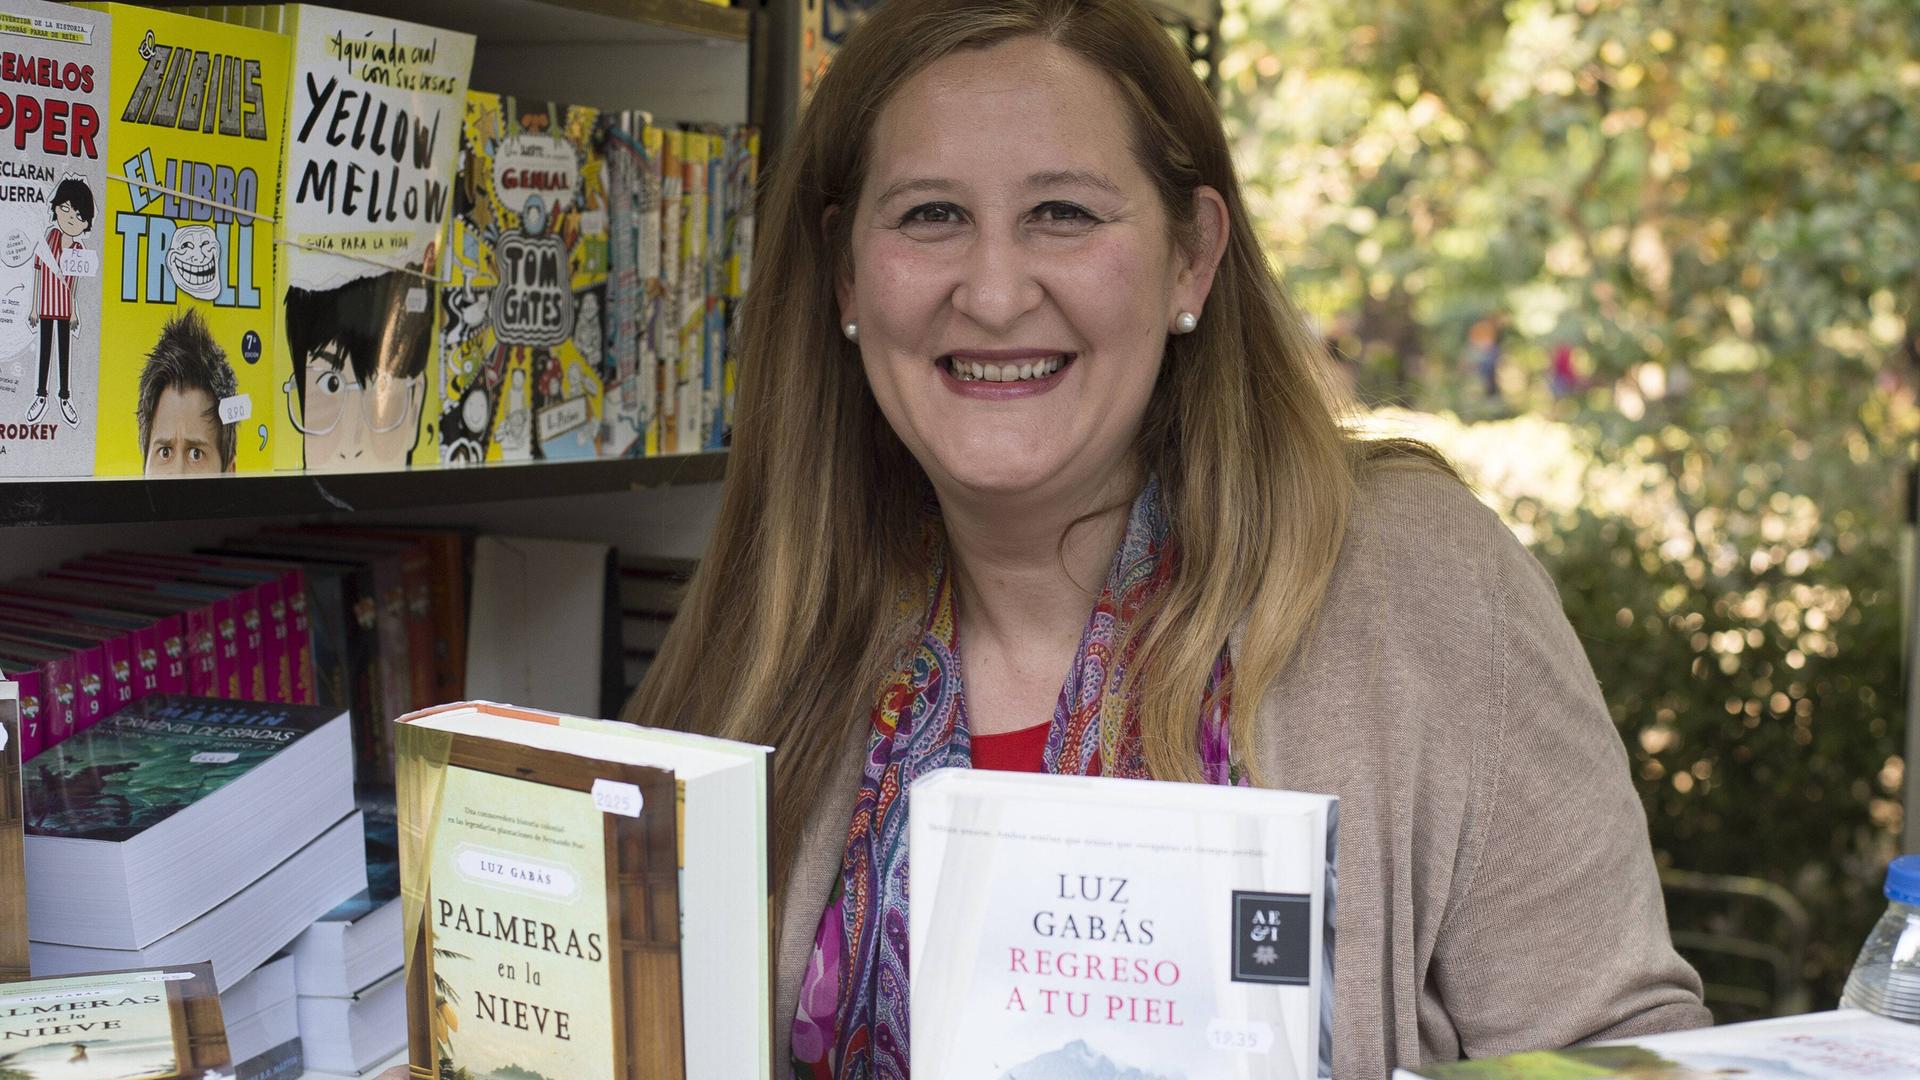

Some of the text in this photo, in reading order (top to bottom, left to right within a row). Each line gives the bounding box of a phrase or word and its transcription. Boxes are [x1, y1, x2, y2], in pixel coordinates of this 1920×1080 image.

[0, 14, 31, 25] IVERTIDA
[34, 19, 42, 27] DE
[331, 28, 437, 75] Aquí cada cual
[0, 51, 95, 94] EMELOS
[362, 63, 390, 87] con
[417, 72, 456, 95] cosas
[120, 44, 267, 141] RUBIUS
[297, 71, 441, 170] YELLOW
[0, 160, 55, 183] CLARAN
[123, 147, 164, 213] EL
[501, 167, 570, 192] GENIAL
[0, 185, 45, 204] UERRA
[163, 158, 259, 228] LIBRO
[295, 159, 449, 224] MELLOW
[307, 235, 409, 251] GUÍA PARA LA VIDA
[63, 259, 90, 274] 1260
[505, 248, 558, 288] TOM
[503, 288, 562, 327] GATES
[0, 423, 58, 440] RODKEY
[224, 645, 236, 658] 16
[249, 634, 260, 648] 17
[170, 662, 183, 677] 13
[202, 658, 215, 672] 15
[119, 687, 131, 700] 10
[145, 674, 156, 689] 11
[65, 710, 73, 723] 8
[90, 701, 99, 715] 9
[156, 707, 287, 727] MARTIN
[29, 723, 37, 738] 7
[194, 726, 220, 736] DE
[219, 727, 295, 741] ESPADAS
[480, 859, 552, 886] LUZ GABÁS
[1058, 873, 1129, 905] LUZ
[1033, 908, 1155, 946] GABÁS
[1252, 909, 1281, 926] AE
[438, 898, 602, 963] PALMERAS
[497, 961, 541, 987] en la
[1009, 947, 1181, 987] REGRESO
[474, 990, 572, 1042] NIEVE
[1005, 986, 1185, 1027] A TU PIEL
[6, 1019, 122, 1040] NIEVE
